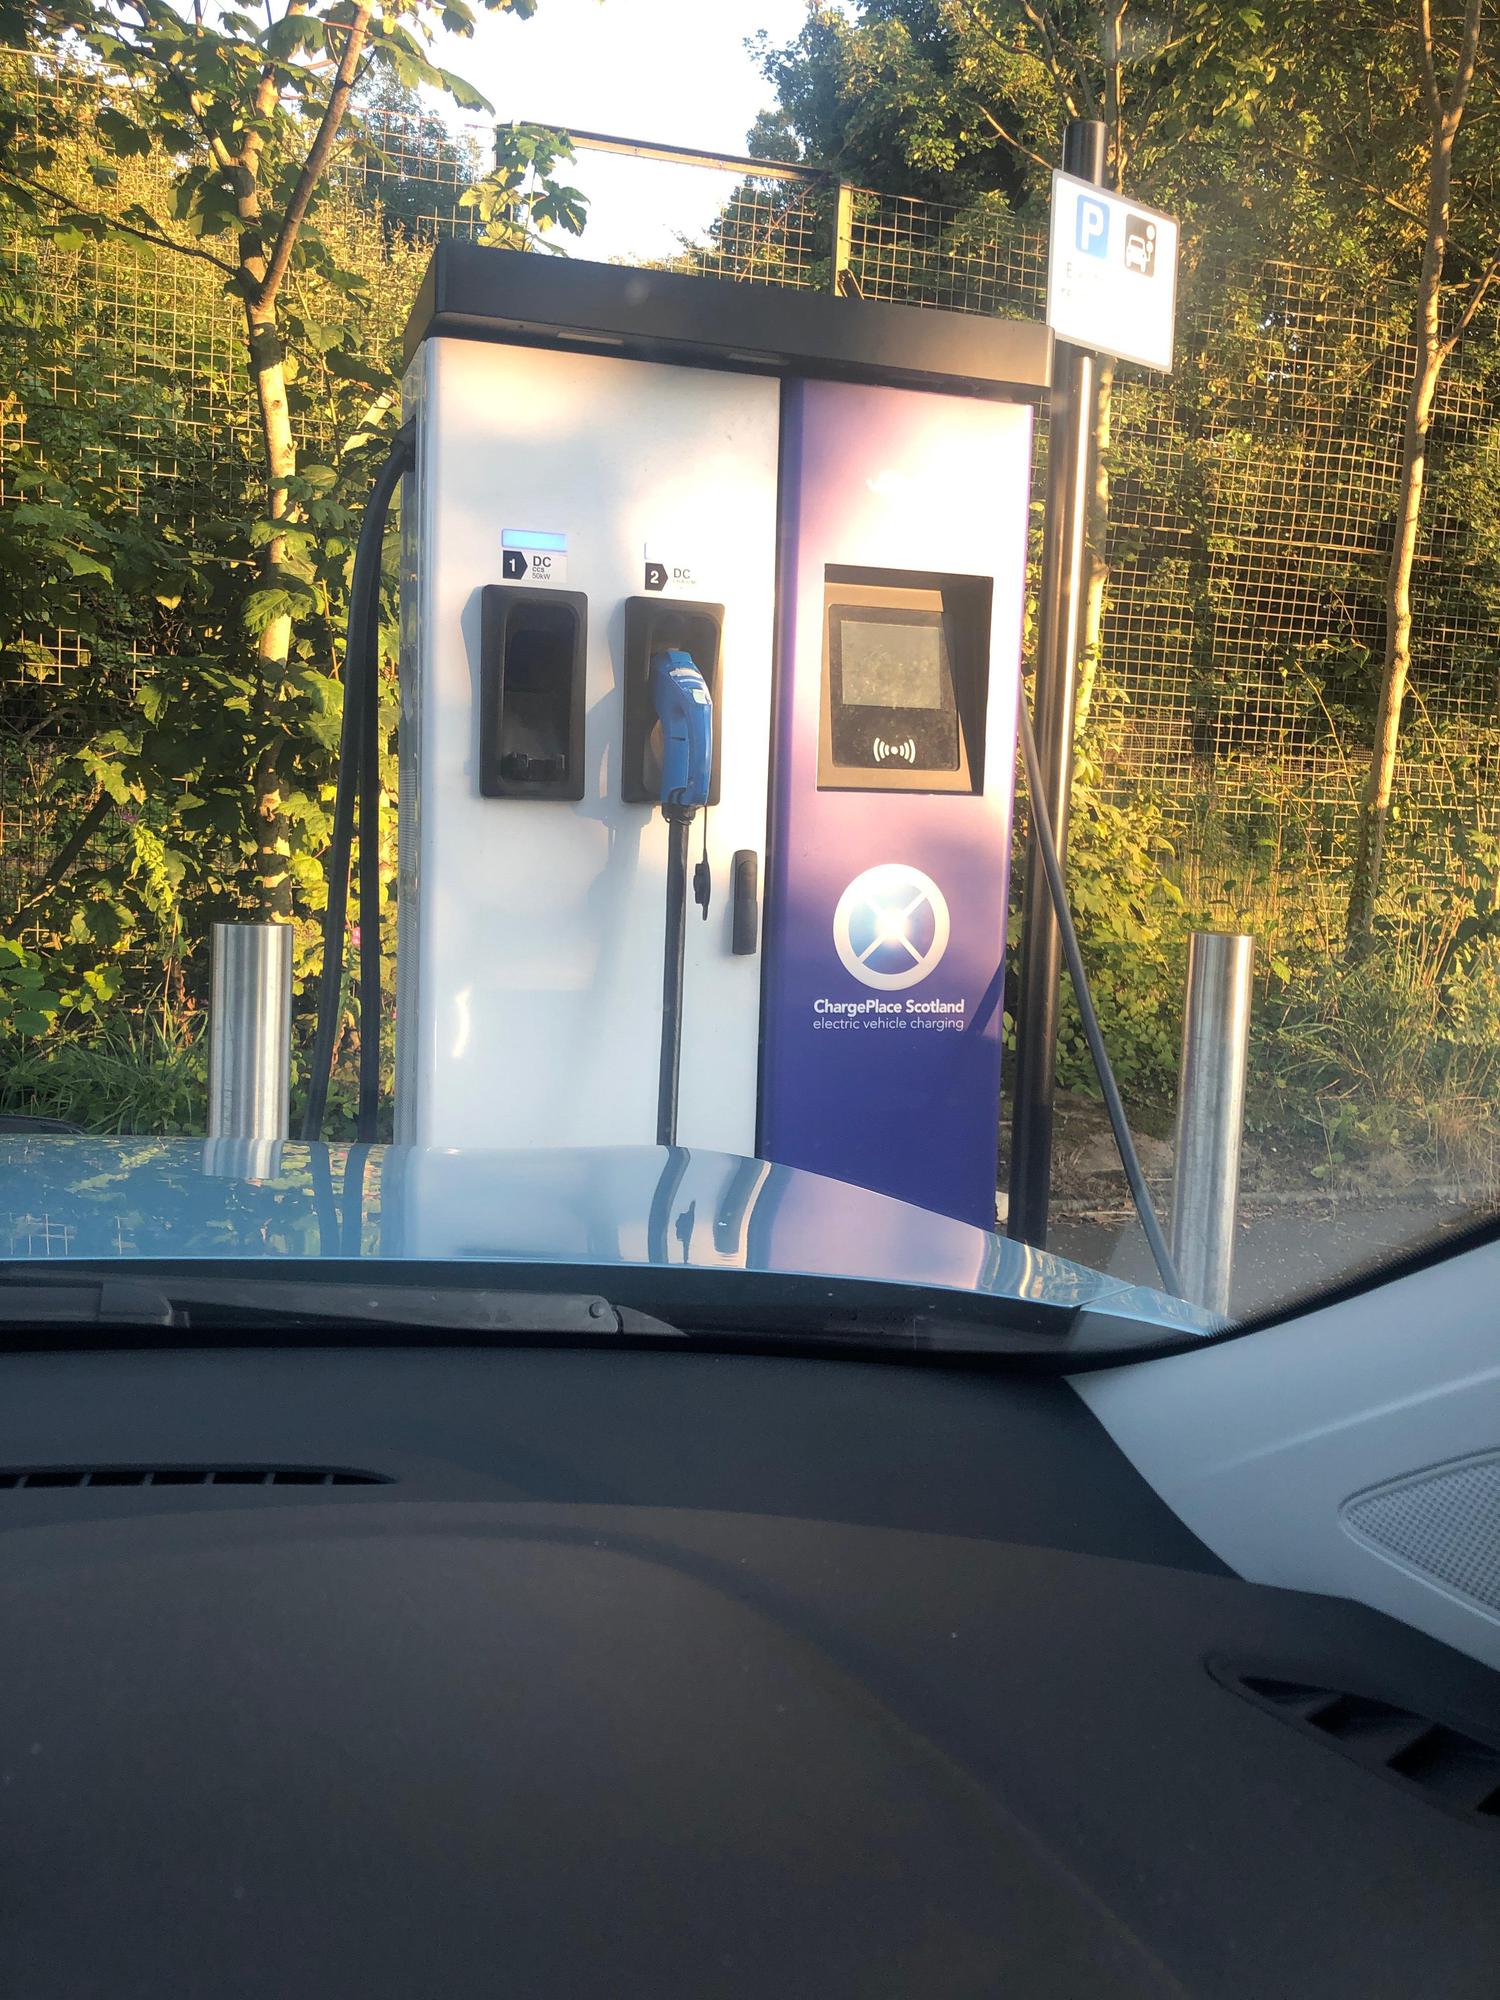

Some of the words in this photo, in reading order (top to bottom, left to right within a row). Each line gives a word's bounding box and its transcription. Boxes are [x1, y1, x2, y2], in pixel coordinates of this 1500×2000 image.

[1081, 201, 1104, 250] P
[509, 558, 516, 572] 1
[533, 555, 552, 568] DC
[650, 570, 659, 584] 2
[673, 568, 691, 579] DC
[813, 999, 902, 1017] ChargePlace
[905, 999, 965, 1014] Scotland
[813, 1017, 860, 1030] electric
[863, 1018, 907, 1029] vehicle
[910, 1017, 964, 1032] charging
